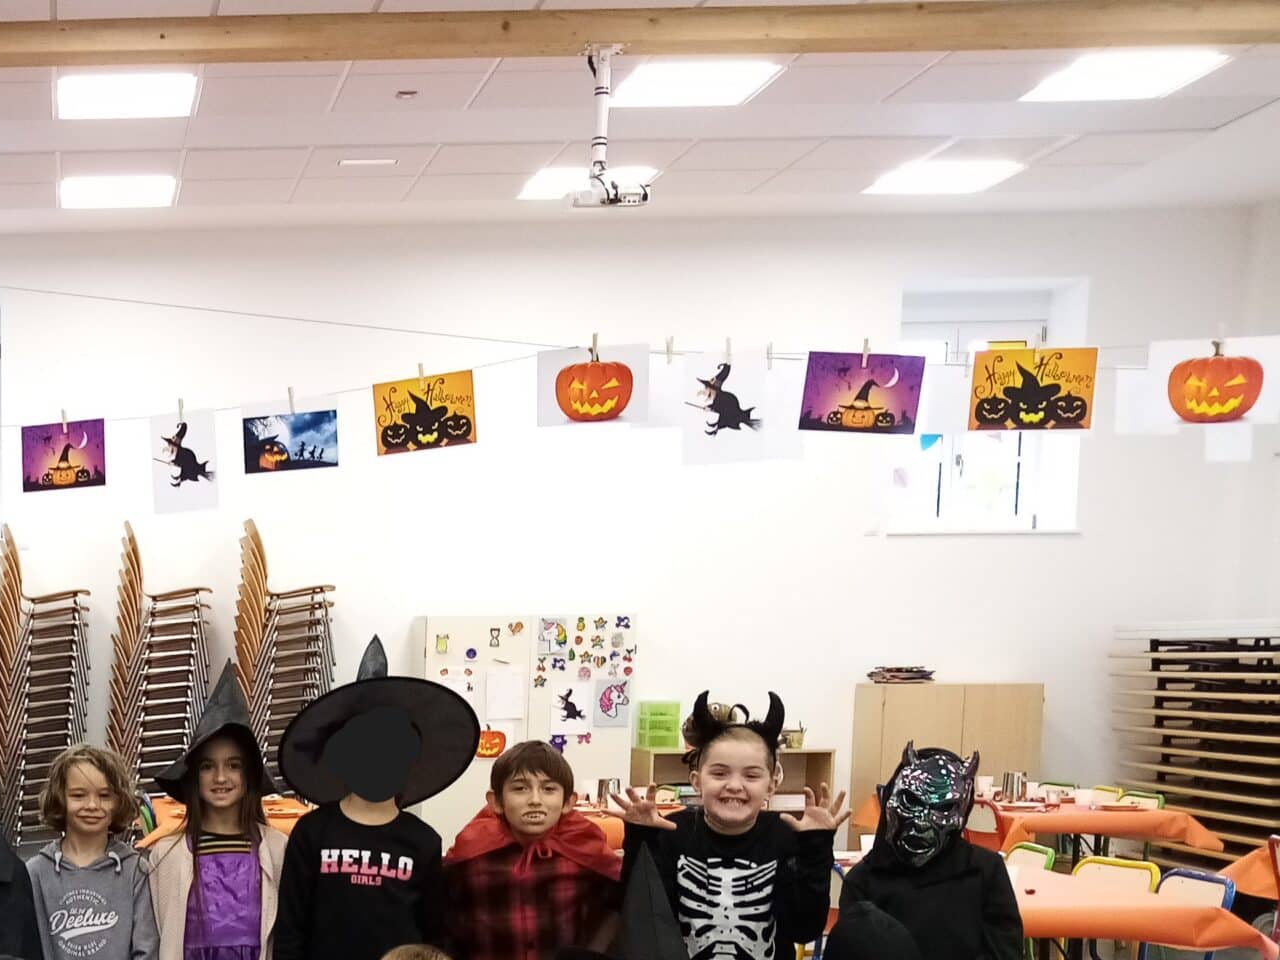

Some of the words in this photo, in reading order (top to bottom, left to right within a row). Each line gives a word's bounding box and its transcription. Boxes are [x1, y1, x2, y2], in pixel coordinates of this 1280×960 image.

[320, 848, 414, 881] HELLO
[350, 874, 382, 886] GIRLS
[65, 894, 100, 905] AUTHENTIC
[49, 907, 119, 936] Deeluxe
[57, 940, 86, 957] ORIGINAL
